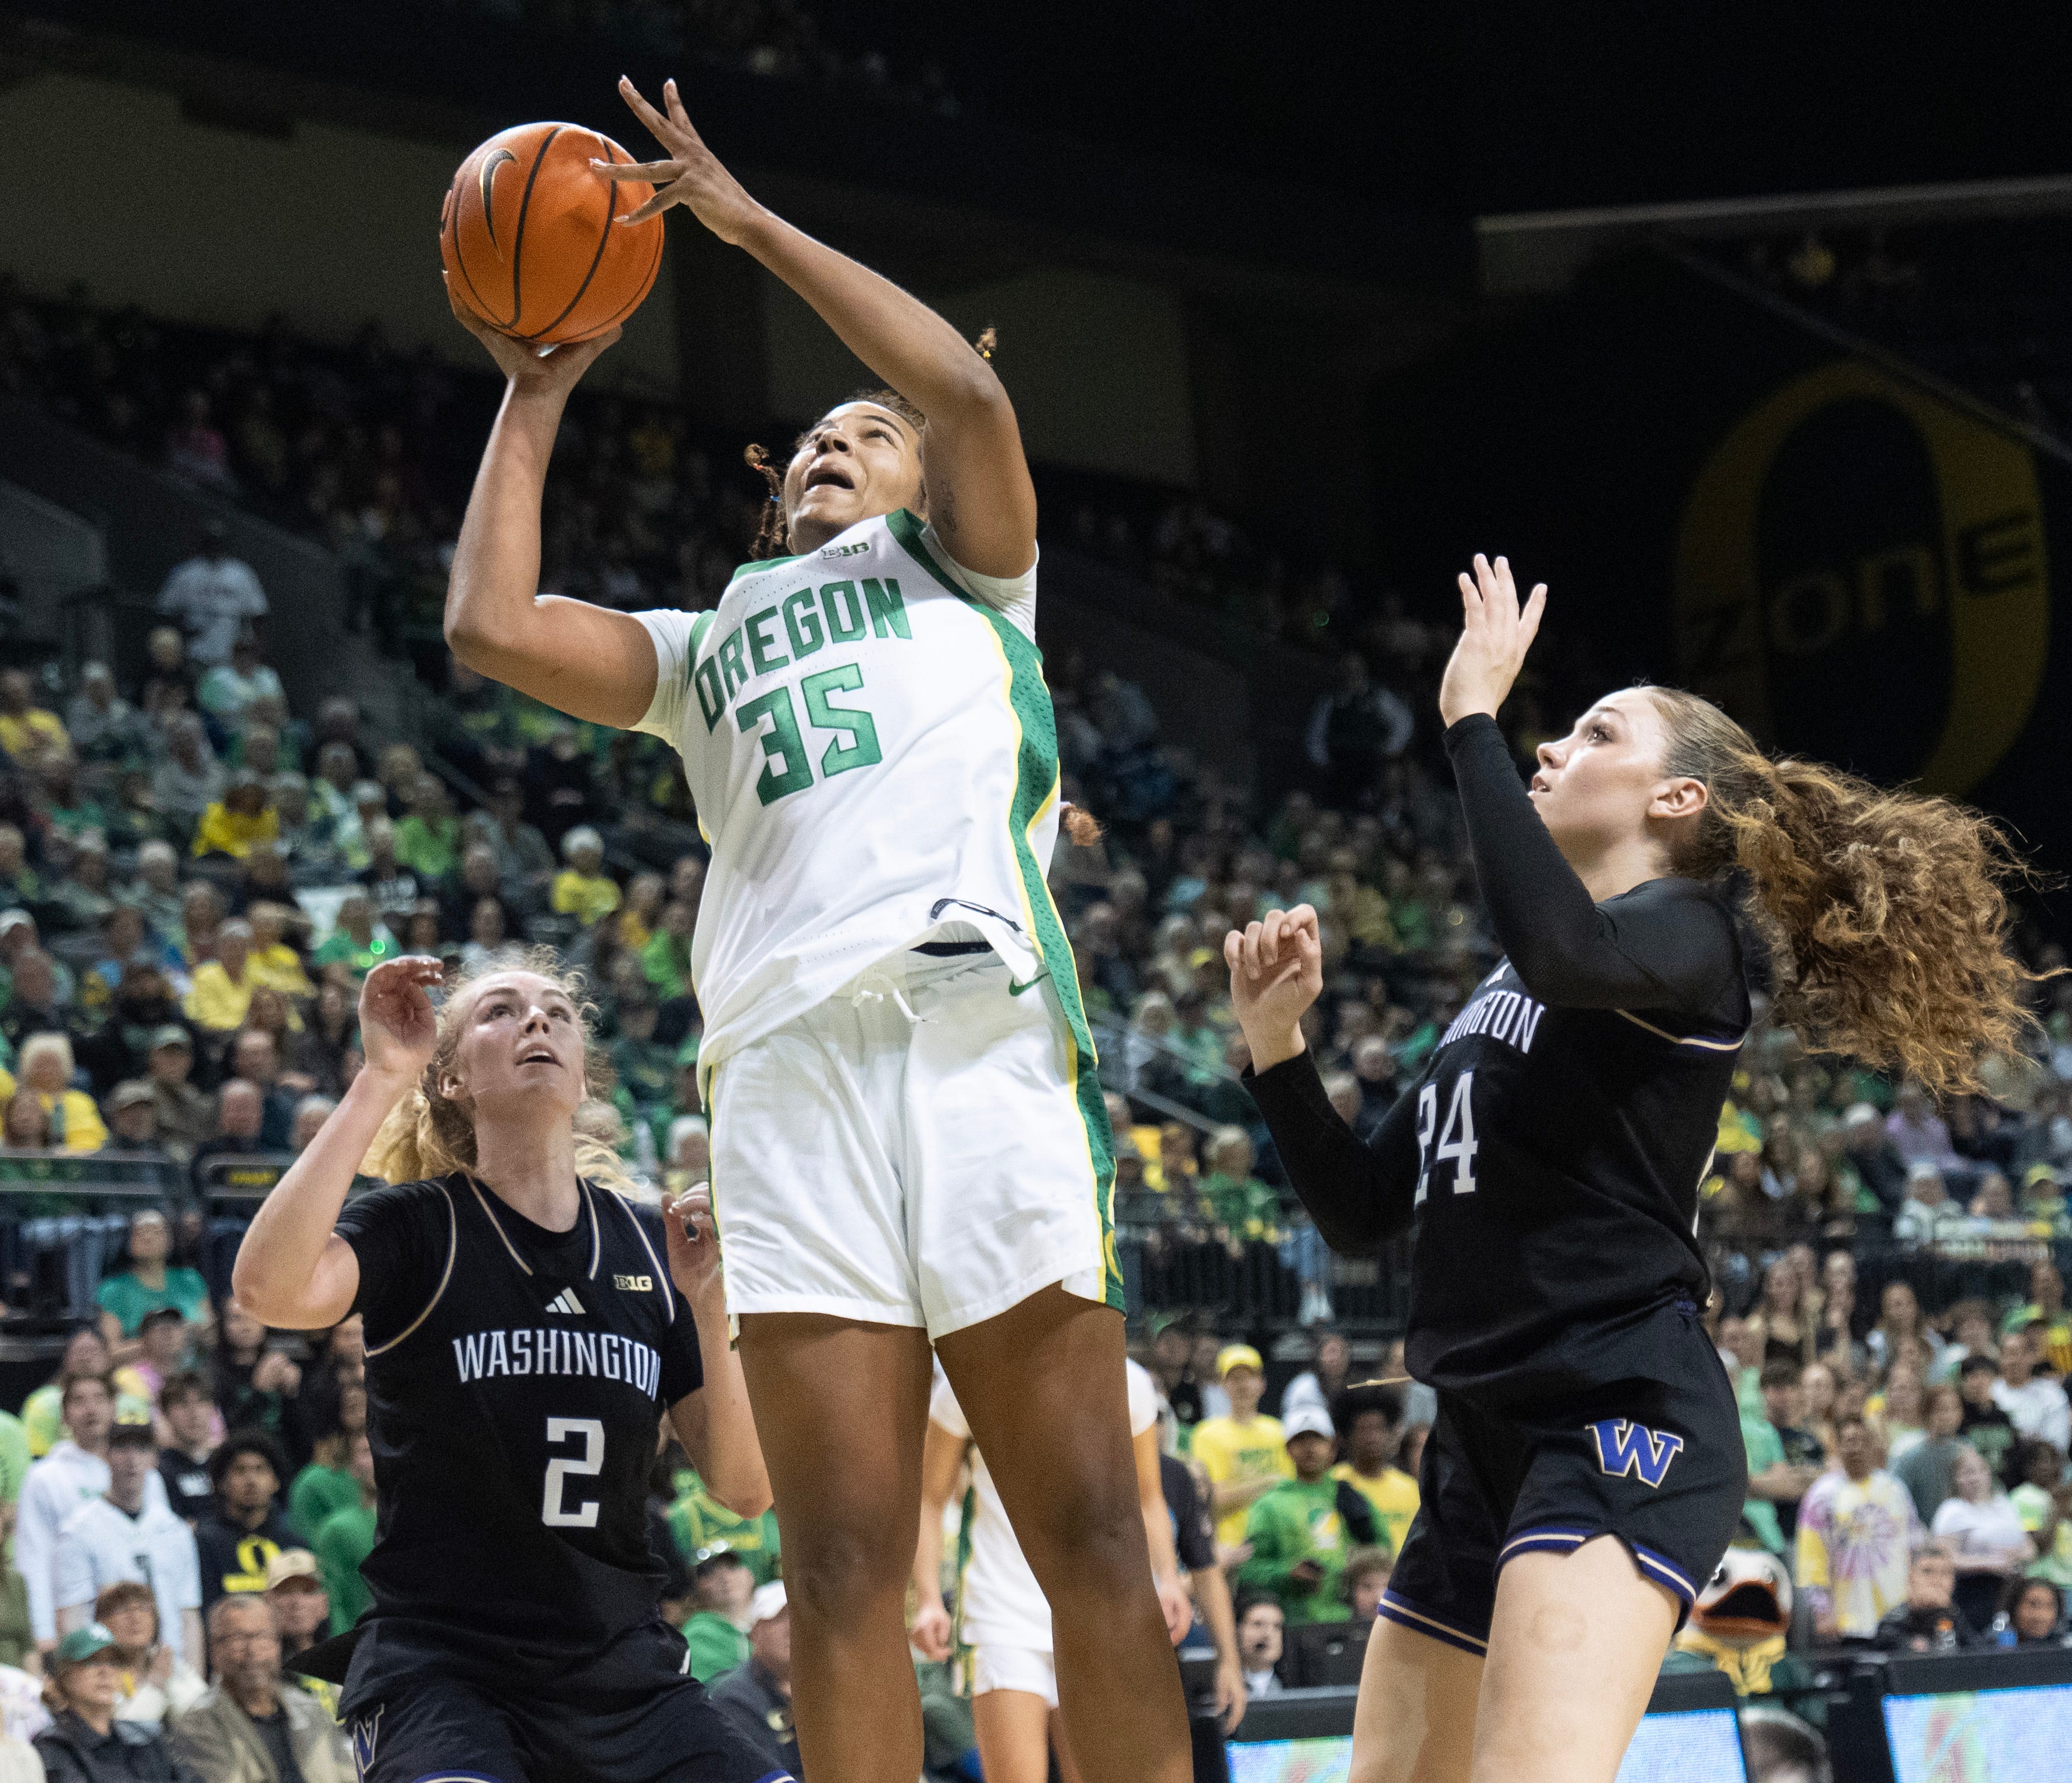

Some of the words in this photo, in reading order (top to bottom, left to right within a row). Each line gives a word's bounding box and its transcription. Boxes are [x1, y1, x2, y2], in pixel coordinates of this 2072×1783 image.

[696, 578, 913, 735] OREGON
[735, 663, 883, 807] 35
[1414, 1071, 1478, 1206] 24
[452, 1329, 661, 1402] WASHINGTON
[541, 1417, 605, 1528] 2
[1584, 1418, 1684, 1489] W
